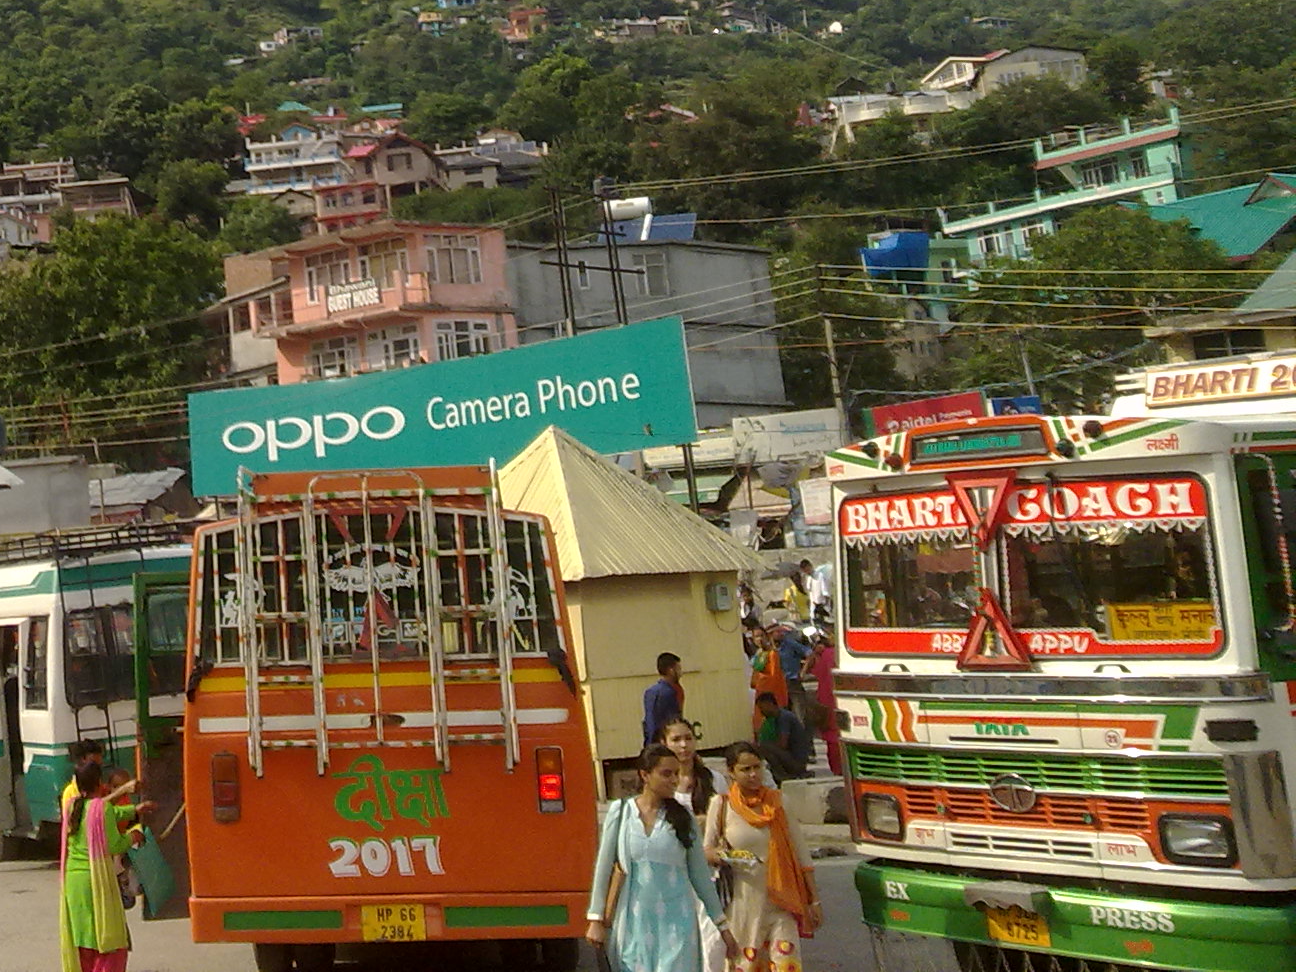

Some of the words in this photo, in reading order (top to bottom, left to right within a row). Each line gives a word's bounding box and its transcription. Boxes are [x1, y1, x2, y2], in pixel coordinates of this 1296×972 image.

[328, 292, 351, 312] GUEST
[353, 287, 379, 308] HOUSE
[1152, 367, 1259, 400] BHARTI
[426, 390, 531, 430] Camera
[537, 373, 641, 414] Phone
[901, 414, 937, 429] airtel
[1007, 481, 1194, 520] COACH
[931, 634, 966, 651] ABB
[1029, 634, 1090, 653] APPU
[331, 753, 451, 831] दीक्षा
[328, 835, 446, 878] 2017
[1106, 842, 1137, 857] लाभ
[377, 907, 393, 923] HP
[399, 907, 417, 923] 66
[884, 880, 911, 901] EX
[1089, 906, 1176, 933] PRESS
